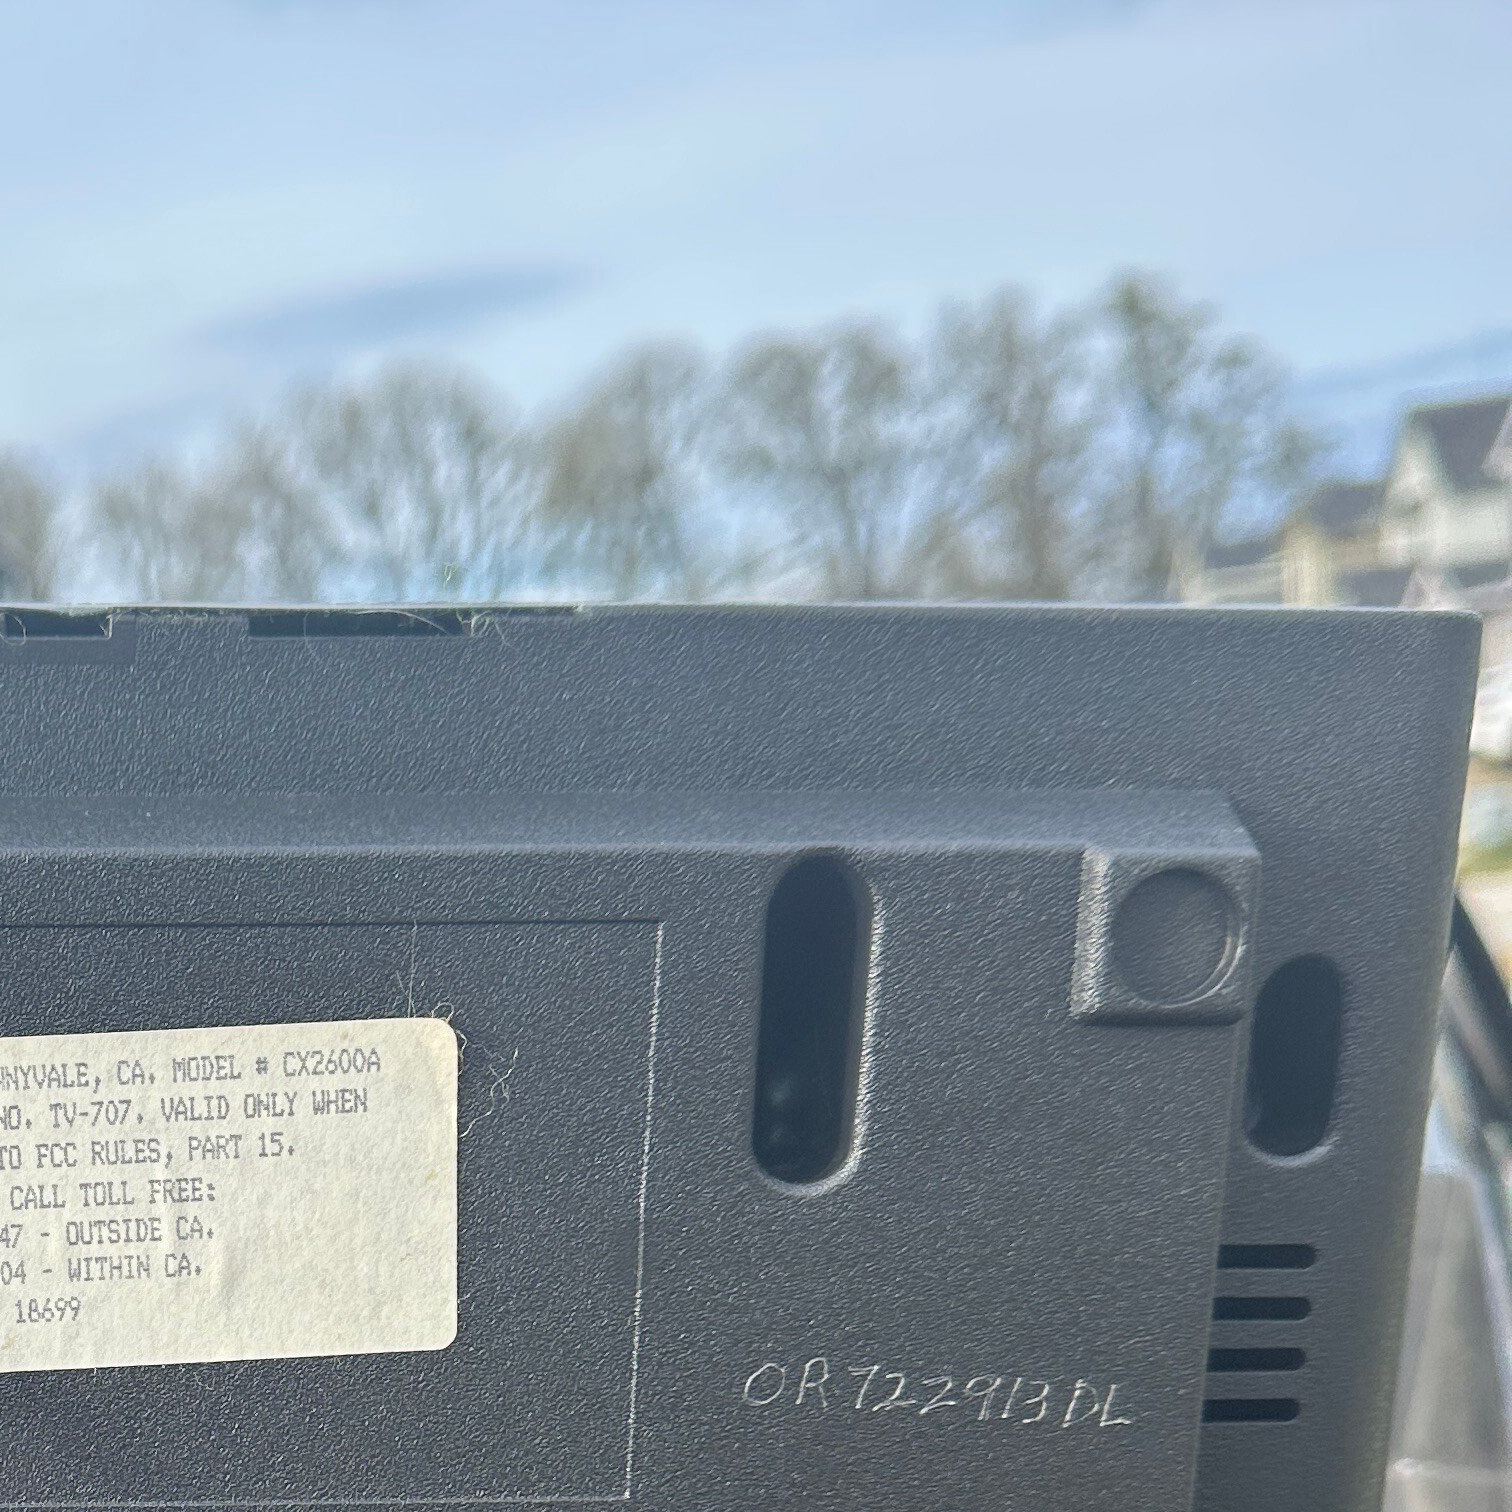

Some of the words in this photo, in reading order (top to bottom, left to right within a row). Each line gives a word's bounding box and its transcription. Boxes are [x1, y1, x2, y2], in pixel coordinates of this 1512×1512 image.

[115, 1059, 157, 1086] CA.
[171, 1054, 242, 1084] MODEL
[254, 1055, 270, 1076] #
[281, 1047, 382, 1078] CX2600A
[48, 1099, 145, 1130] TV-707.
[160, 1094, 231, 1123] VALID
[243, 1090, 299, 1120] ONLY
[311, 1087, 369, 1117] WHEN
[35, 1142, 79, 1169] FCC
[90, 1138, 174, 1169] RULES,
[187, 1133, 244, 1162] PART
[258, 1131, 296, 1158] 15.
[9, 1183, 67, 1211] CALL
[78, 1180, 136, 1208] TOLL
[147, 1176, 217, 1205] FREE:
[65, 1216, 164, 1247] OUTSIDE
[175, 1215, 215, 1241] CA.
[67, 1254, 151, 1283] WITHIN
[163, 1252, 203, 1279] CA.
[14, 1296, 83, 1325] 18699
